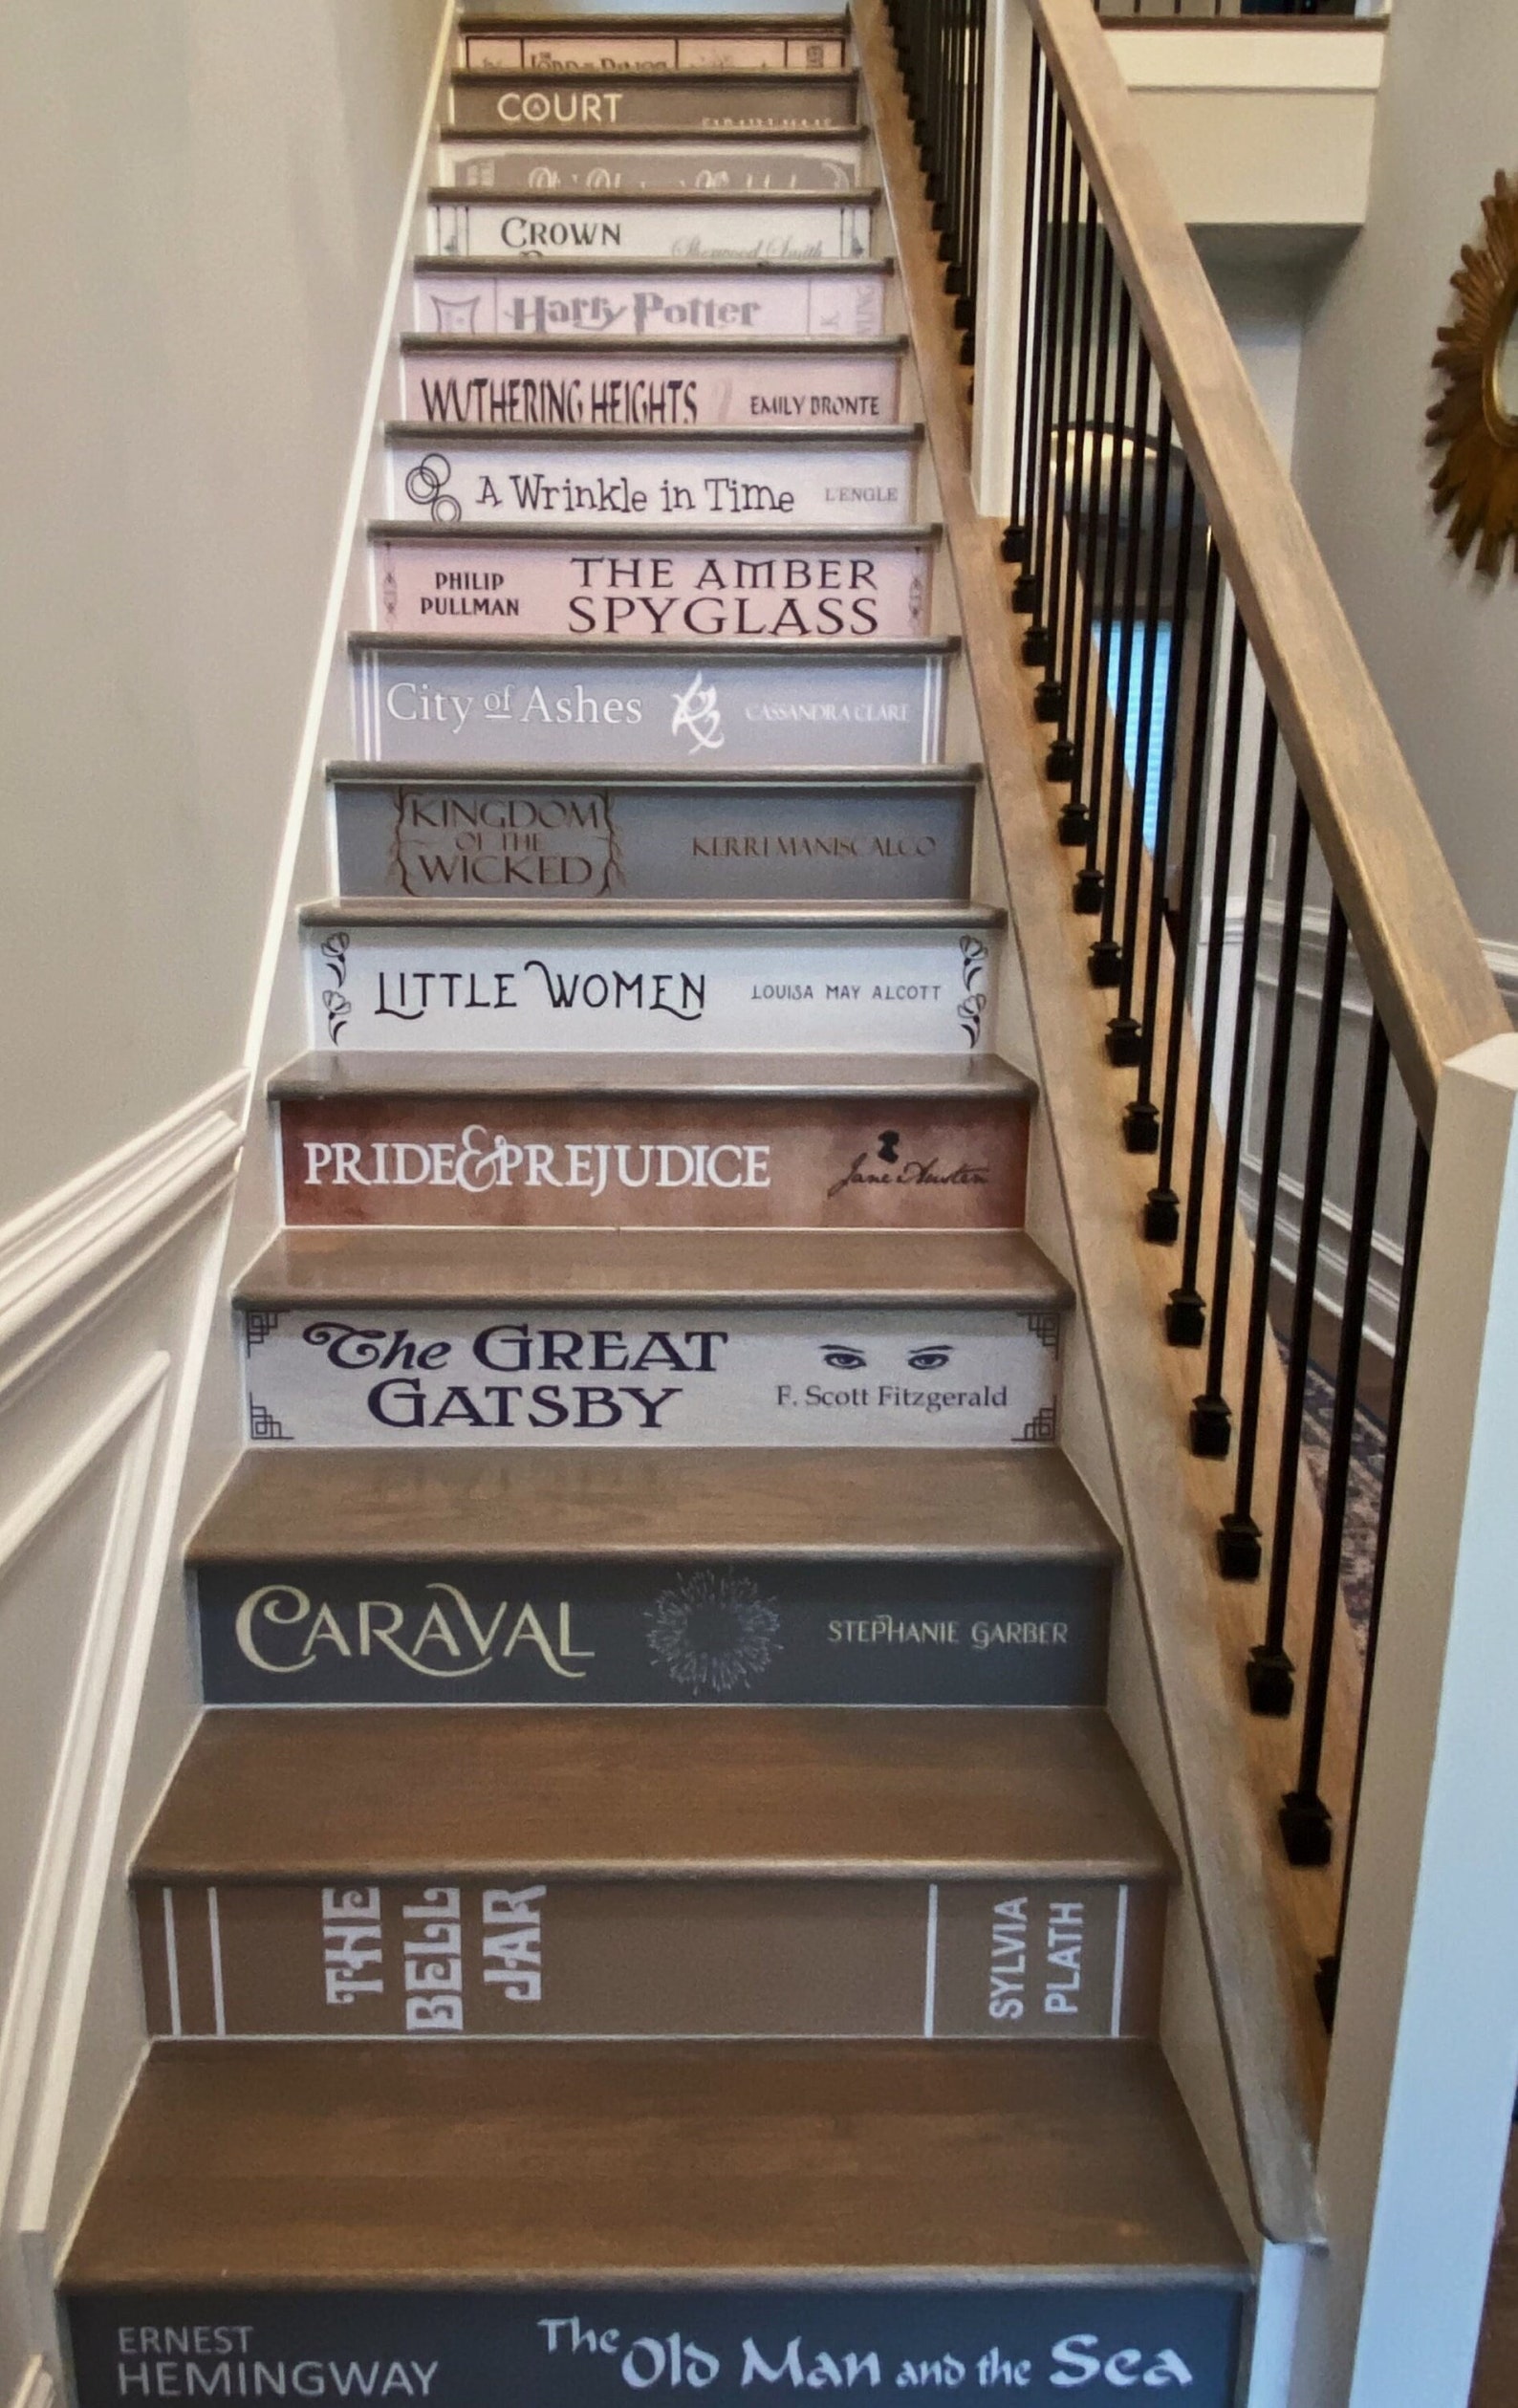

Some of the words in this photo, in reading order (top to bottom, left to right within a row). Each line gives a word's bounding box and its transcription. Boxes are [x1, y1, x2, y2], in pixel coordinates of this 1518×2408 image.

[497, 92, 623, 122] COURT
[500, 216, 621, 249] CROWN
[504, 294, 628, 335] Harry
[633, 292, 762, 335] Potter
[421, 379, 582, 423] WUTHERING
[590, 380, 698, 423] HEIGHTS
[749, 395, 805, 416] EMILY
[476, 475, 503, 508] A
[510, 474, 648, 513] Wrinkle
[660, 479, 696, 512] in
[705, 477, 795, 513] Time
[435, 572, 504, 592] PHILIP
[570, 557, 674, 589] THE
[695, 558, 878, 590] AMBER
[421, 597, 519, 618] PULLMAN
[568, 596, 878, 637] SPYGLASS
[386, 682, 474, 735] City
[483, 683, 515, 712] of
[519, 684, 642, 724] Ashes
[745, 704, 851, 722] CASSANDRA
[412, 799, 599, 829] KINGDOM
[500, 831, 545, 852] THE
[692, 835, 769, 857] KERRI
[418, 855, 593, 884] WICKED
[374, 970, 519, 1020] LITTLE
[524, 959, 706, 1021] WOMEN
[750, 983, 814, 1001] LOUISA
[826, 984, 861, 1001] MAY
[871, 984, 942, 1002] ALCOTT
[826, 1152, 893, 1200] Jane
[895, 1157, 990, 1185] Austen
[302, 1321, 453, 1370] The
[472, 1323, 728, 1372] GREAT
[367, 1378, 683, 1428] GATSBY
[775, 1384, 798, 1407] F.
[804, 1384, 870, 1407] Scott
[878, 1384, 1008, 1414] Fitzgerald
[235, 1582, 596, 1679] CARAVAL
[827, 1614, 960, 1644] STEPHANIE
[970, 1620, 1069, 1650] GARBER
[321, 1886, 384, 2005] THE
[401, 1886, 465, 2031] BELL
[482, 1884, 548, 2002] JAR
[987, 1896, 1030, 2020] SYLVIA
[1044, 1901, 1085, 2014] PLATH
[117, 2325, 254, 2354] ERNEST
[536, 2315, 621, 2354] The
[620, 2332, 721, 2389] Old
[739, 2334, 882, 2389] Man
[894, 2352, 965, 2388] and
[977, 2346, 1032, 2388] the
[1049, 2333, 1194, 2388] Sea
[117, 2359, 440, 2397] HEMINGWAY
